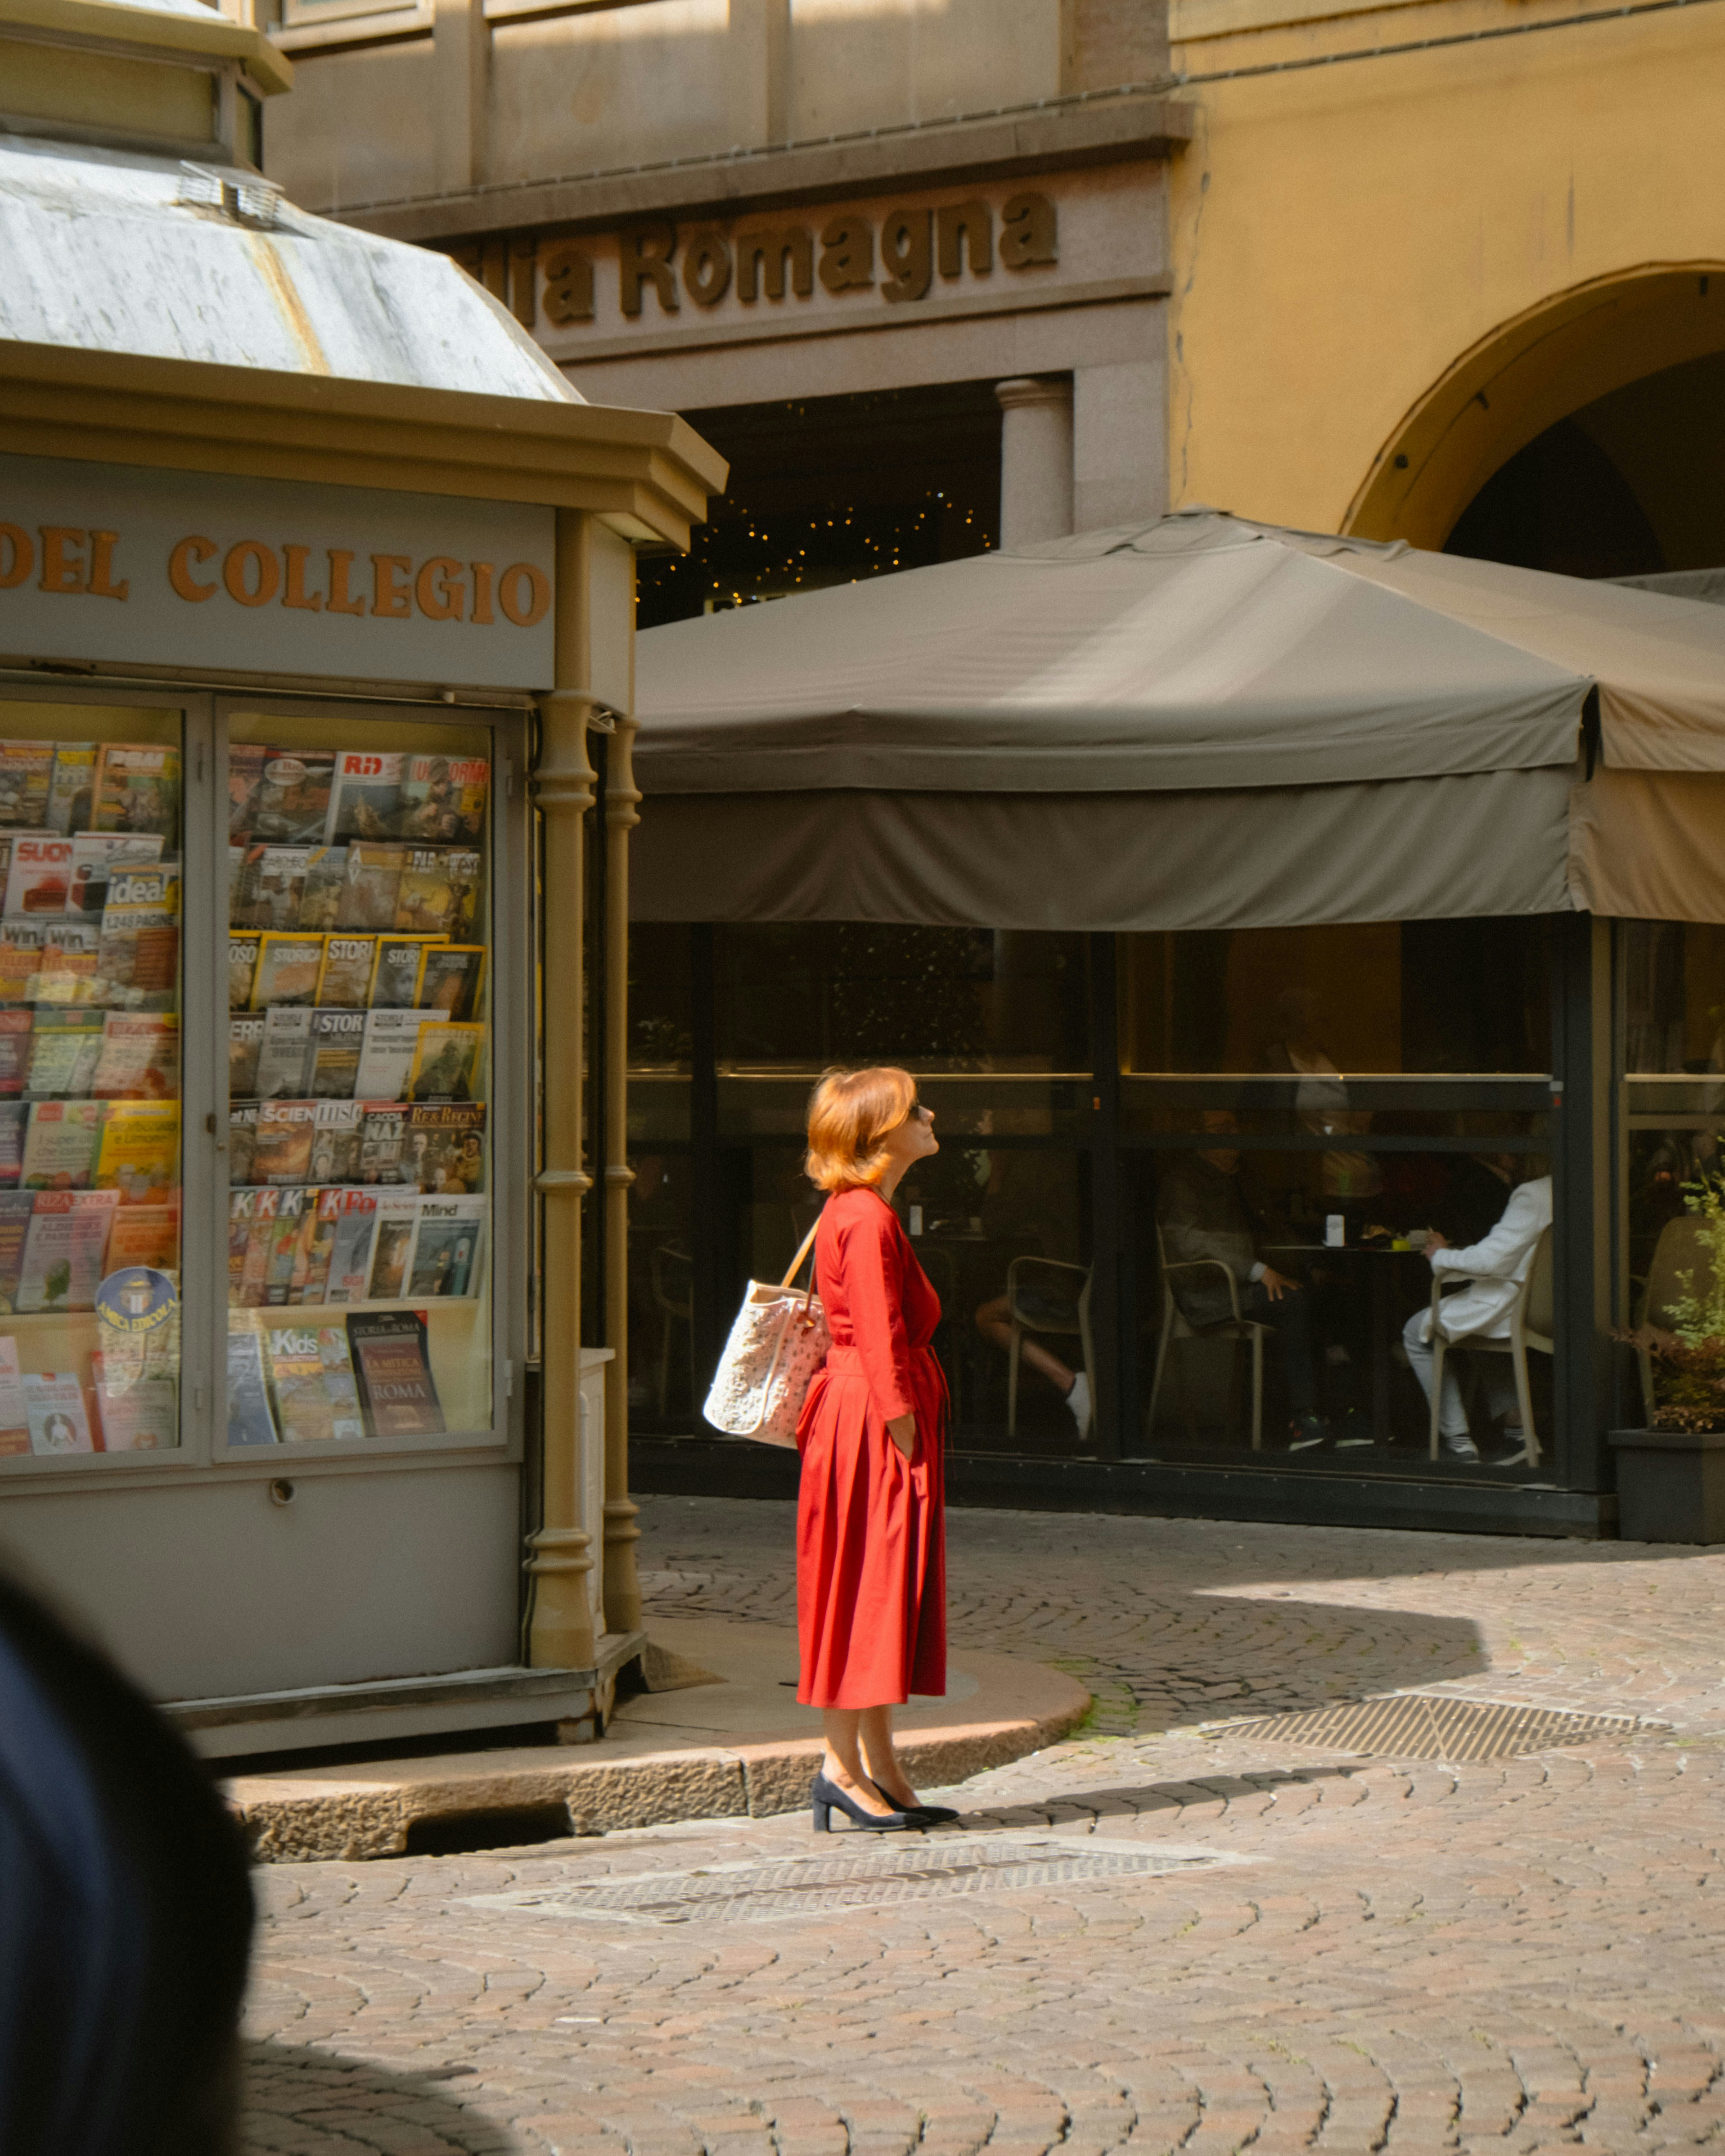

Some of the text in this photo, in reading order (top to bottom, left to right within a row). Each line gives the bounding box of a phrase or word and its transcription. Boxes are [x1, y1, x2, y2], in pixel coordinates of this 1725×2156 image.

[620, 191, 1058, 317] Romagna
[0, 521, 551, 627] DEL COLLEGIO
[422, 1204, 457, 1216] Mind
[270, 1328, 318, 1355] Kids
[372, 1382, 427, 1400] ROMA
